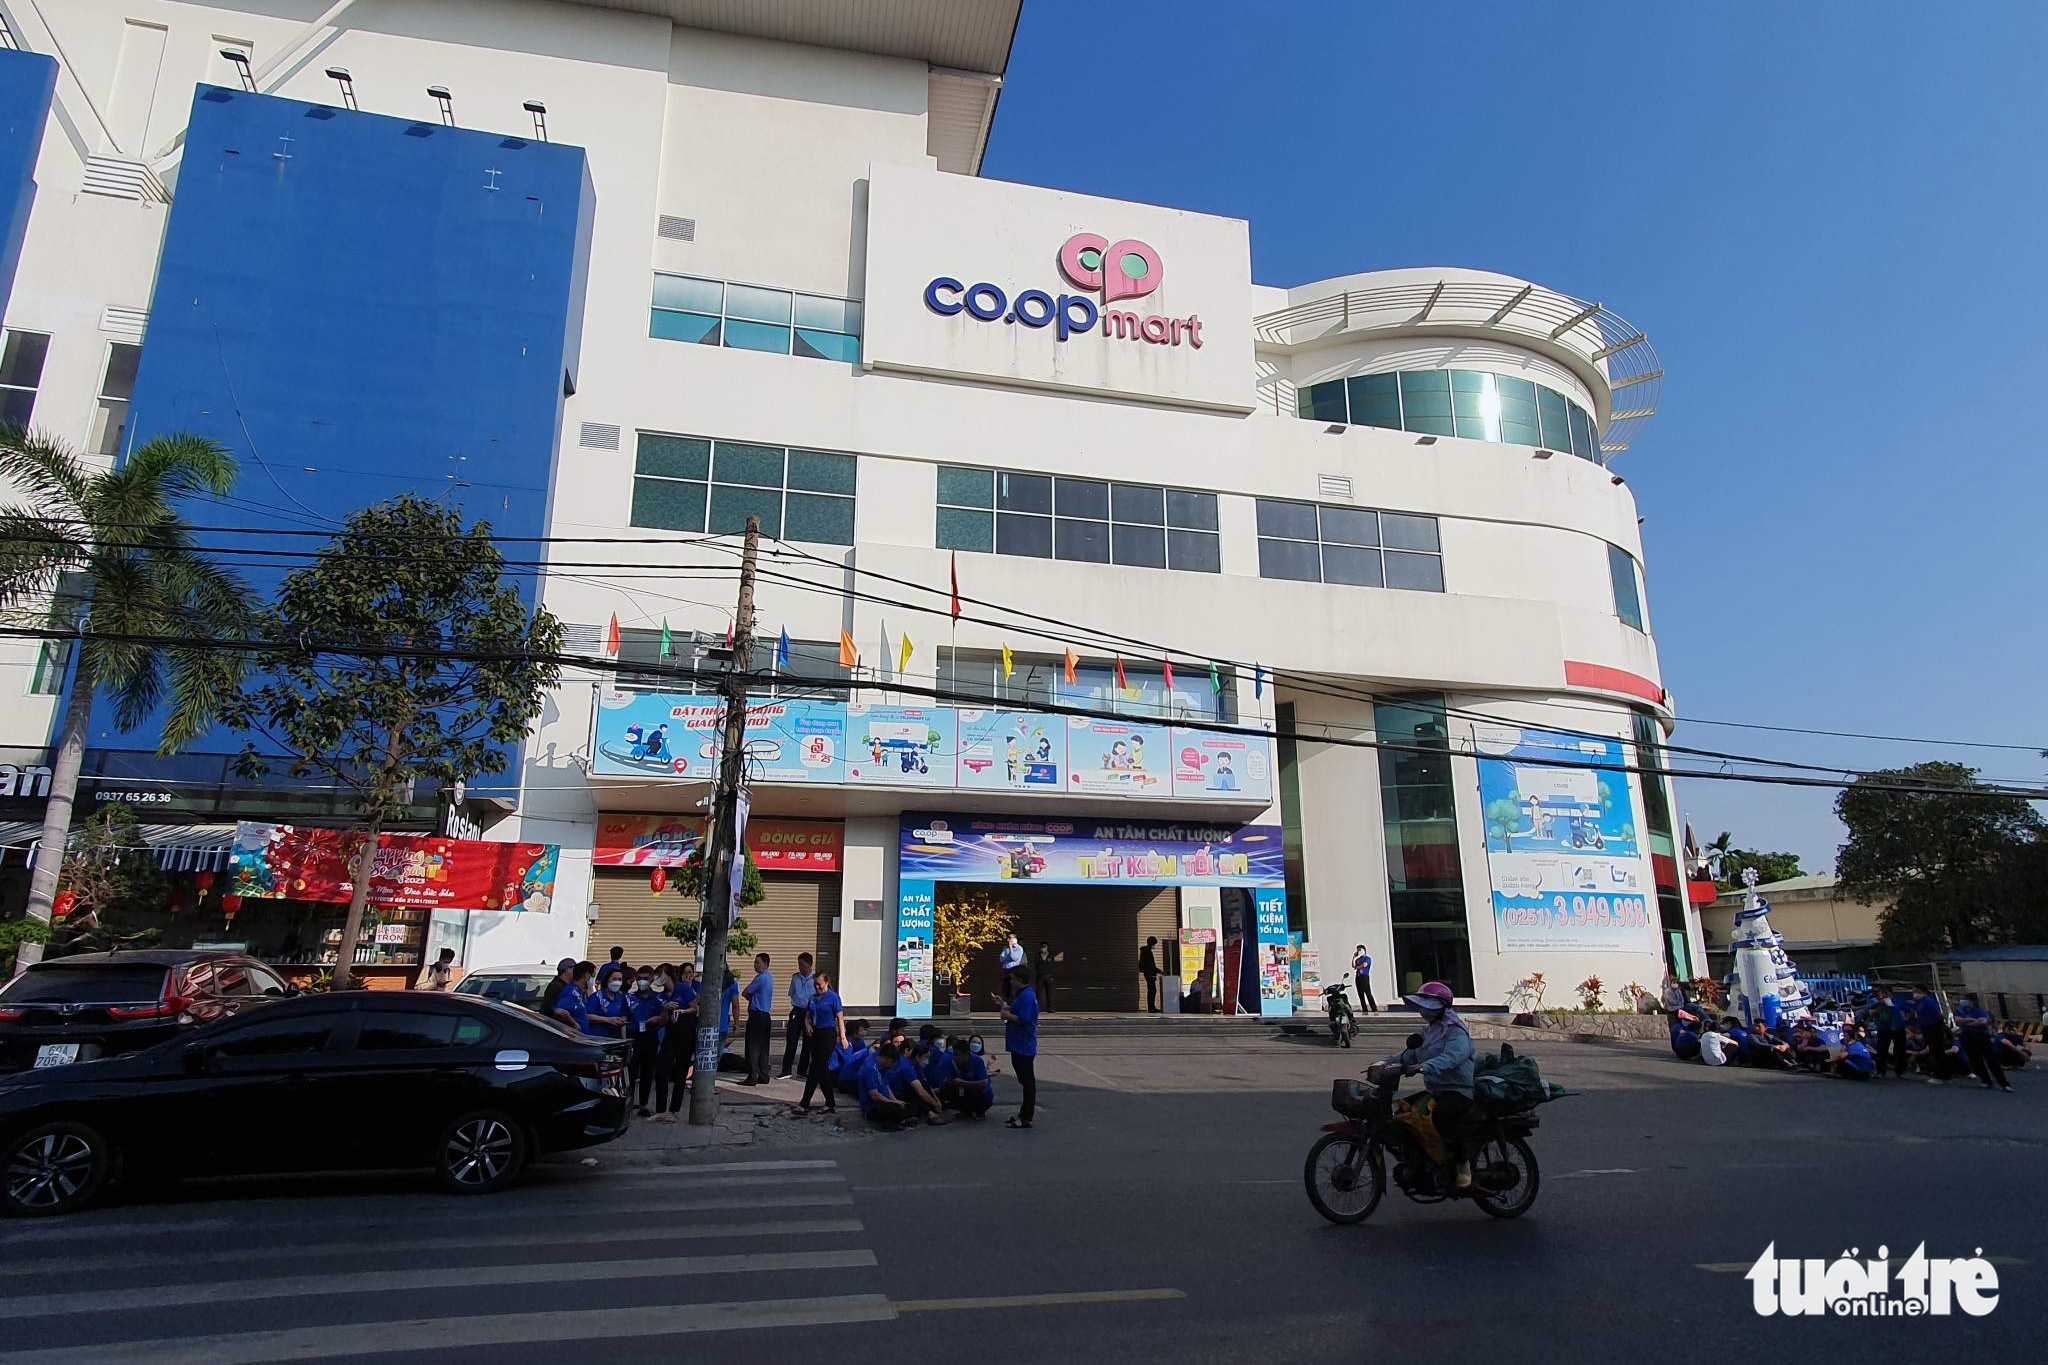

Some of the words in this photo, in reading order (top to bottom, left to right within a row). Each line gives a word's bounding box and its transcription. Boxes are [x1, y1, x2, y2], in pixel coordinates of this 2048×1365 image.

[924, 277, 1098, 342] co.op
[1103, 309, 1204, 350] mart
[95, 791, 123, 801] 0937
[126, 792, 140, 802] 65
[142, 792, 156, 802] 26
[157, 792, 172, 803] 36
[1094, 827, 1113, 839] AN
[1117, 826, 1145, 840] TÂM
[1148, 825, 1184, 840] CHẤT
[916, 894, 931, 903] TÂM
[1258, 898, 1283, 912] TIẾT
[902, 904, 931, 917] CHẤT
[901, 920, 931, 929] LƯỢNG
[1259, 912, 1284, 926] KIỆM
[1502, 907, 1553, 929] (0251)
[1260, 924, 1272, 934] TỐI
